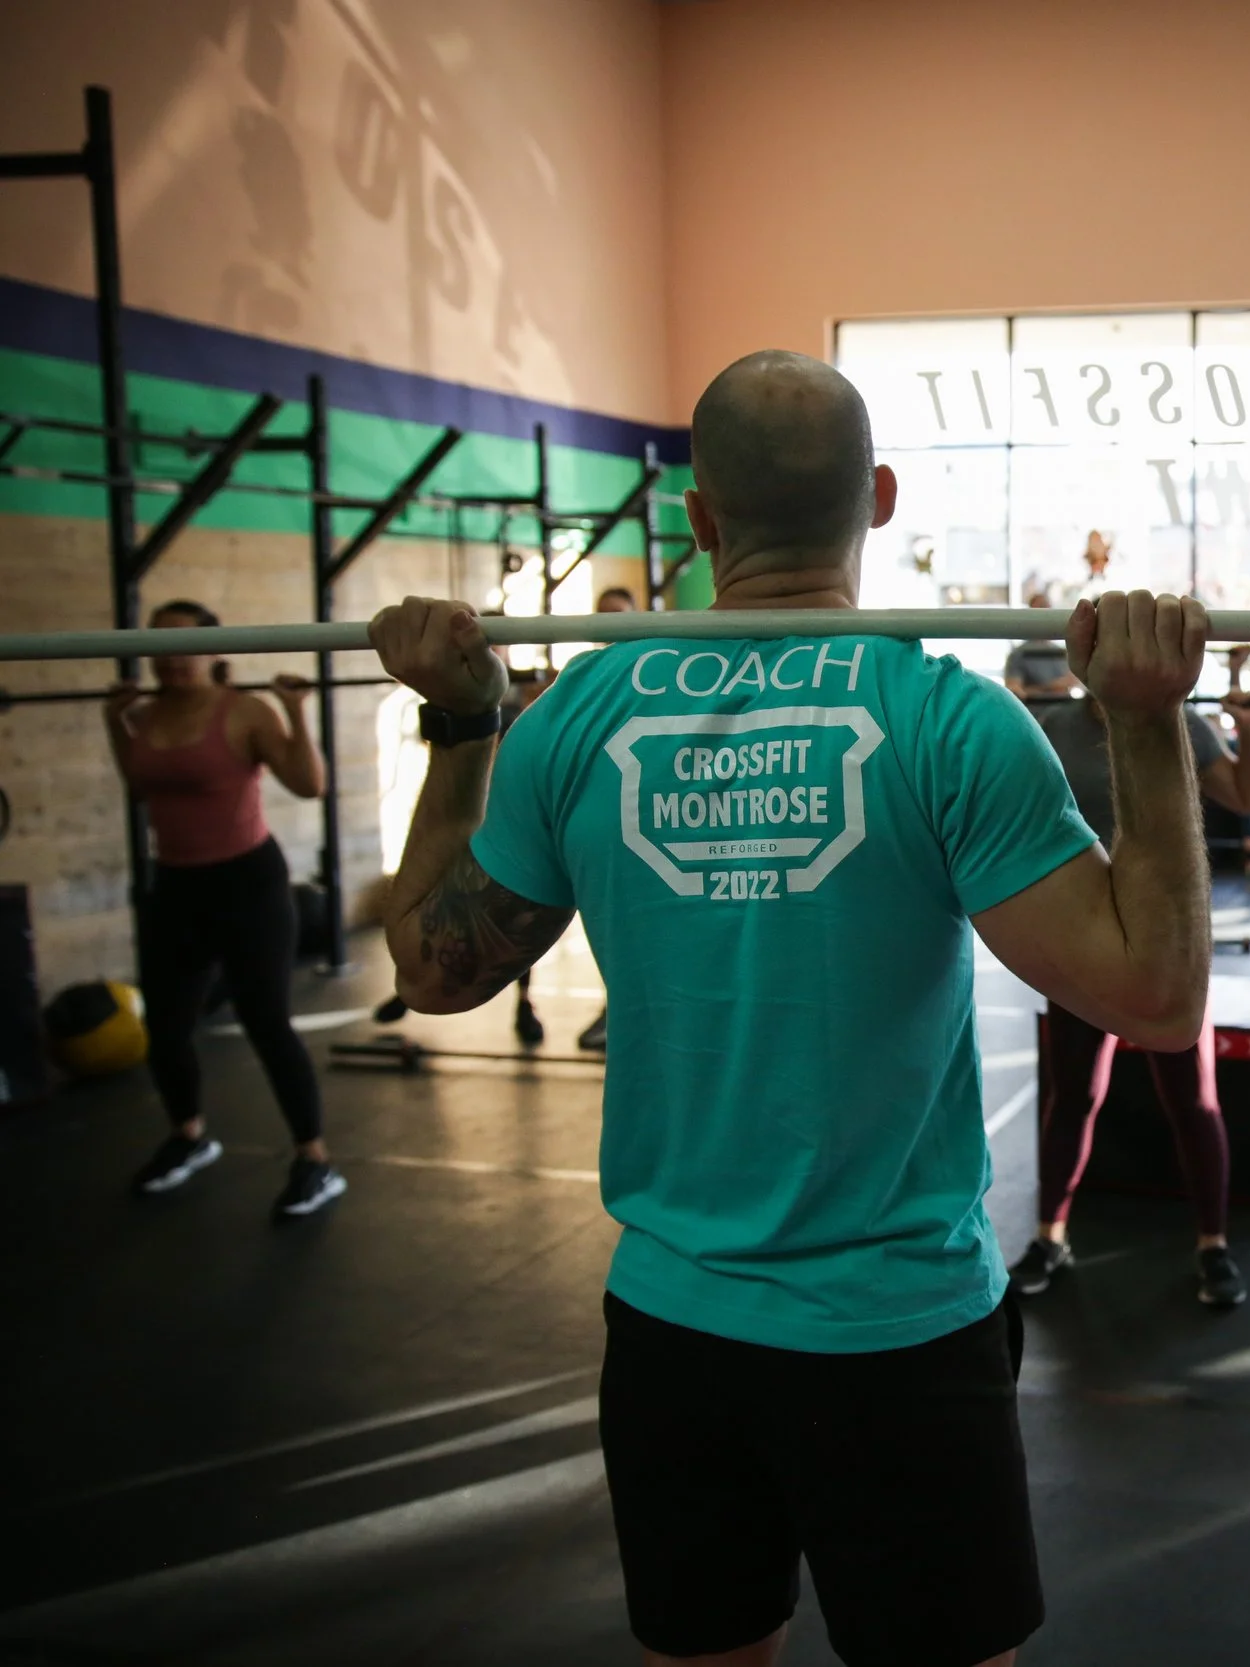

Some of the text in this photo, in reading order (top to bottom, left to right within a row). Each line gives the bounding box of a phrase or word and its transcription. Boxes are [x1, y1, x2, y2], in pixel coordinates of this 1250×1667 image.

[631, 643, 865, 697] COACH
[673, 739, 811, 781] CROSSFIT
[652, 786, 828, 829] MONTROSE
[708, 843, 777, 855] REFORGED
[709, 870, 780, 900] 2022
